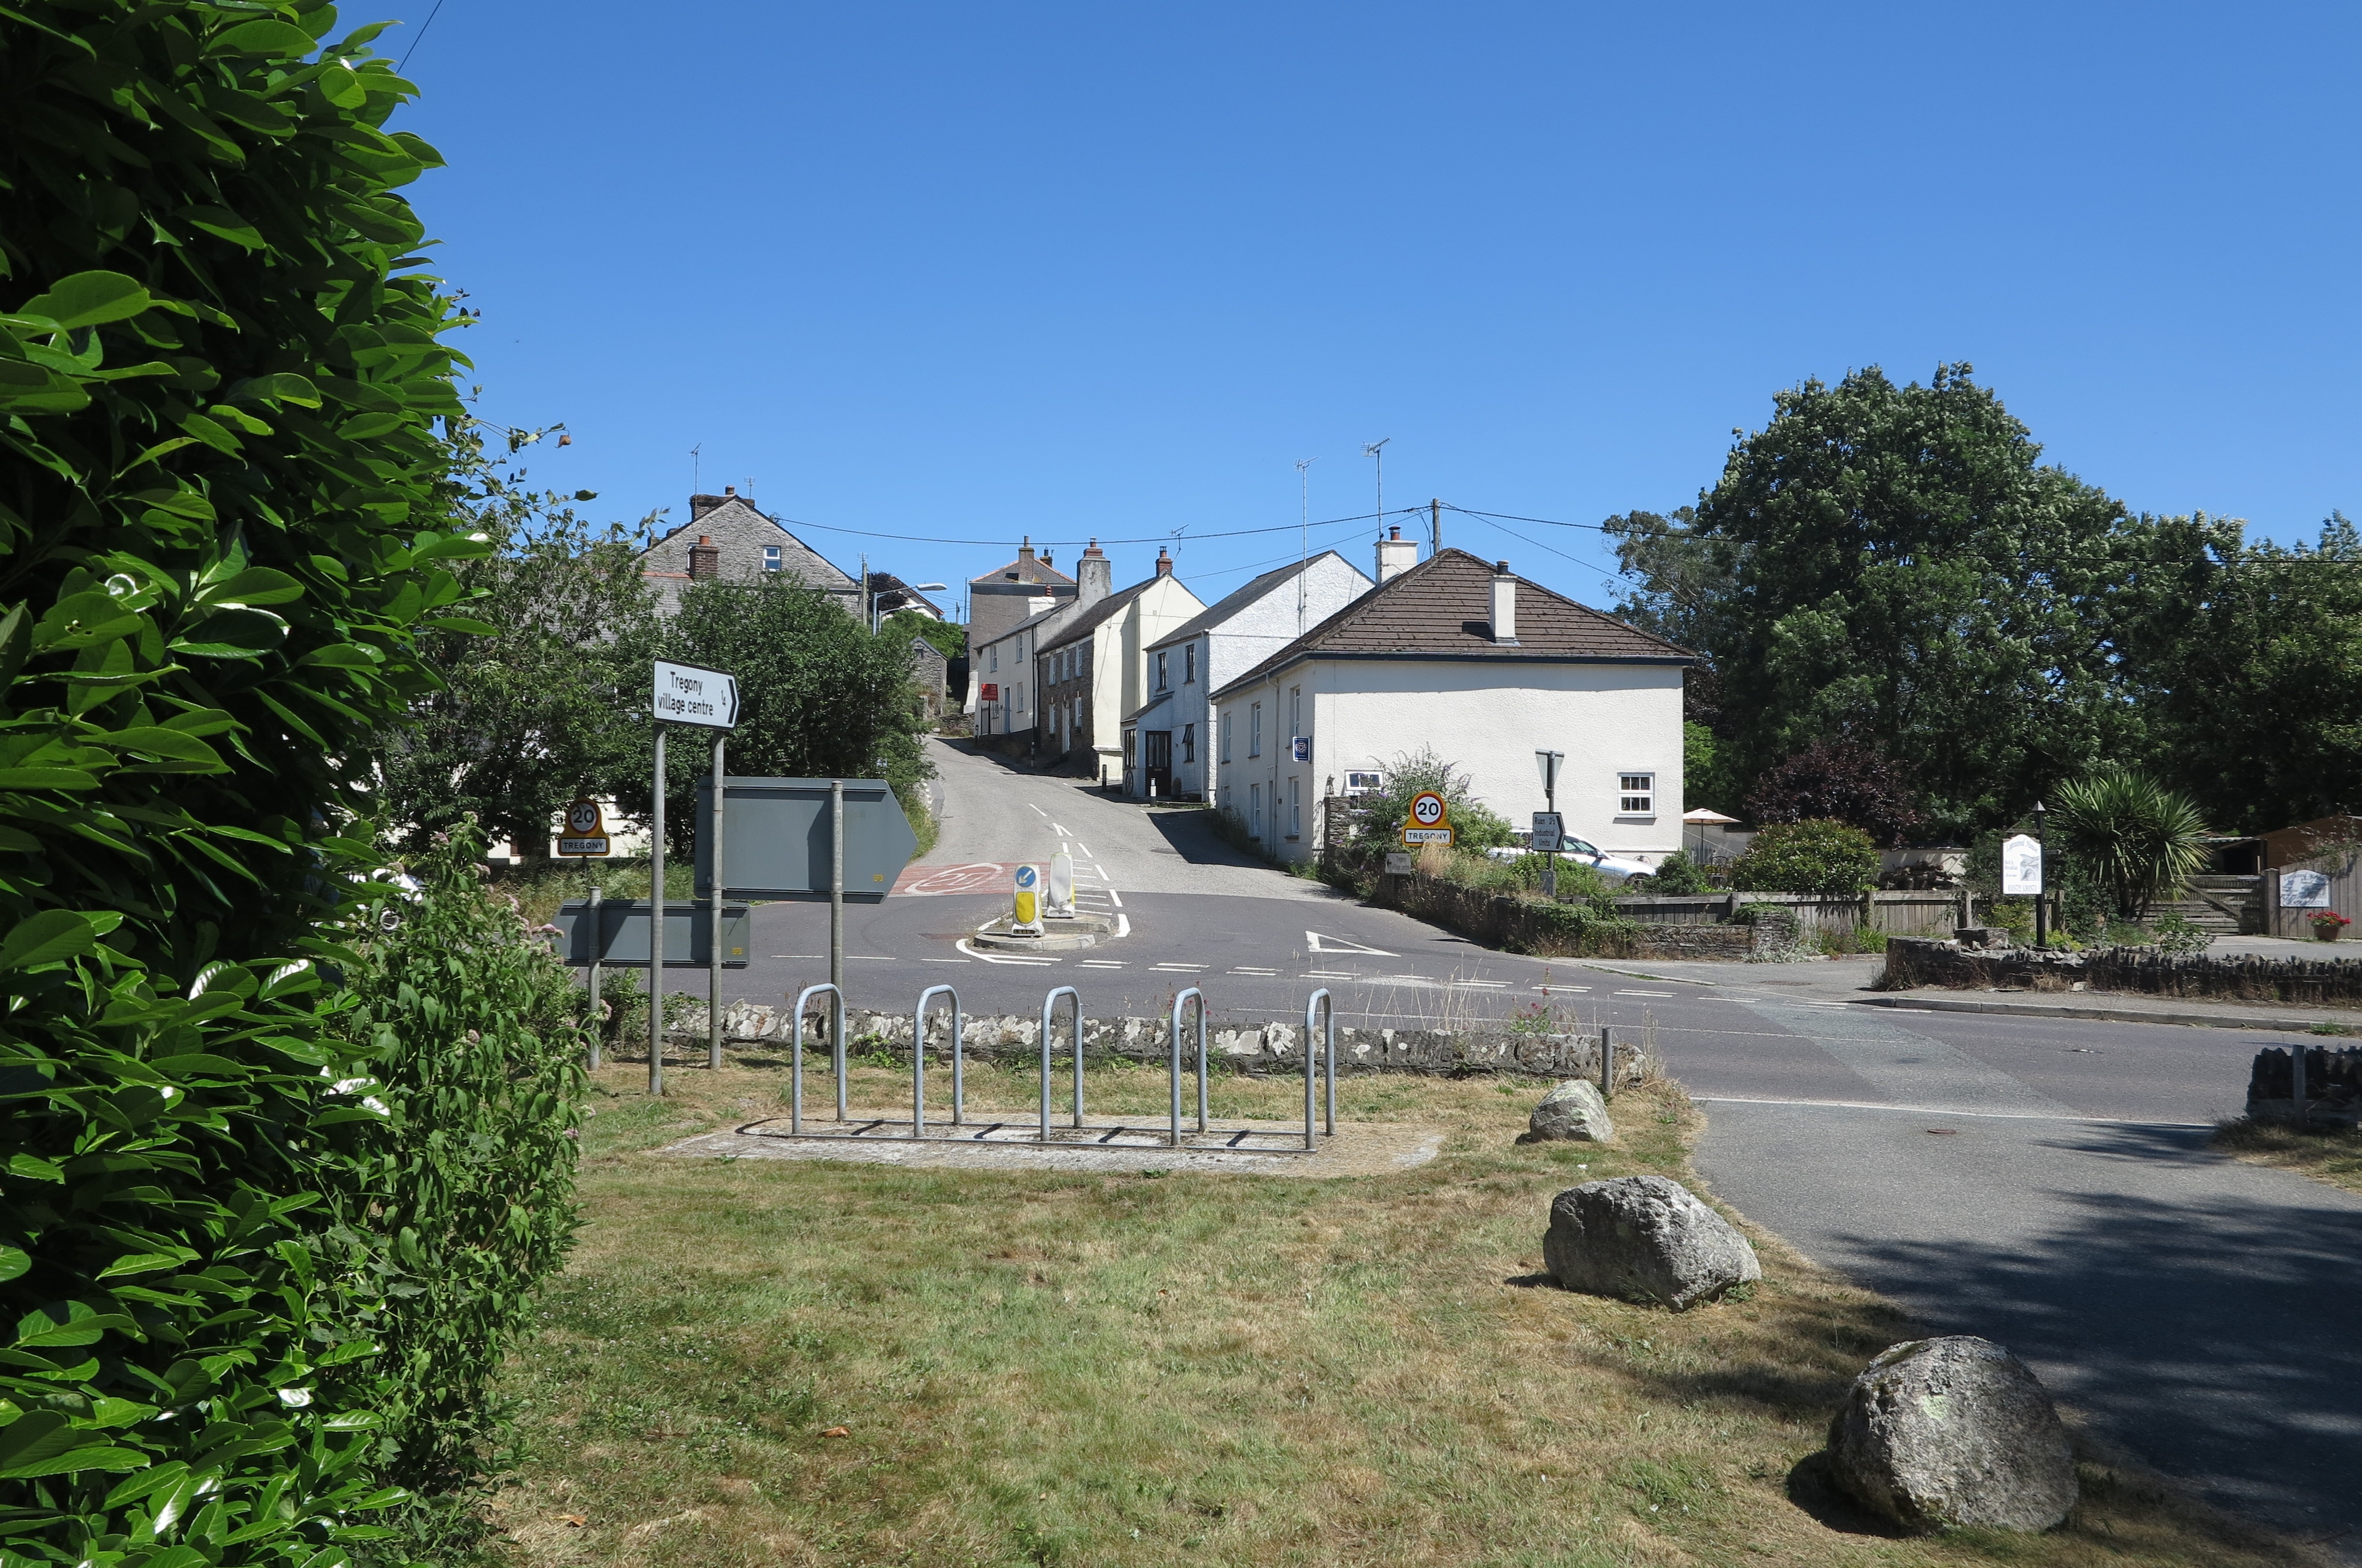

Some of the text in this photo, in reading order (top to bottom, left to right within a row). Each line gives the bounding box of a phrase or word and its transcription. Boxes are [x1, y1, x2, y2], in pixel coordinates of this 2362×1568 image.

[670, 671, 703, 696] Tregony
[658, 692, 714, 716] village centre
[1417, 802, 1439, 816] 20
[573, 809, 595, 824] 20
[1534, 816, 1545, 825] Ruan
[1534, 828, 1555, 837] Industrial
[1539, 838, 1550, 846] Units
